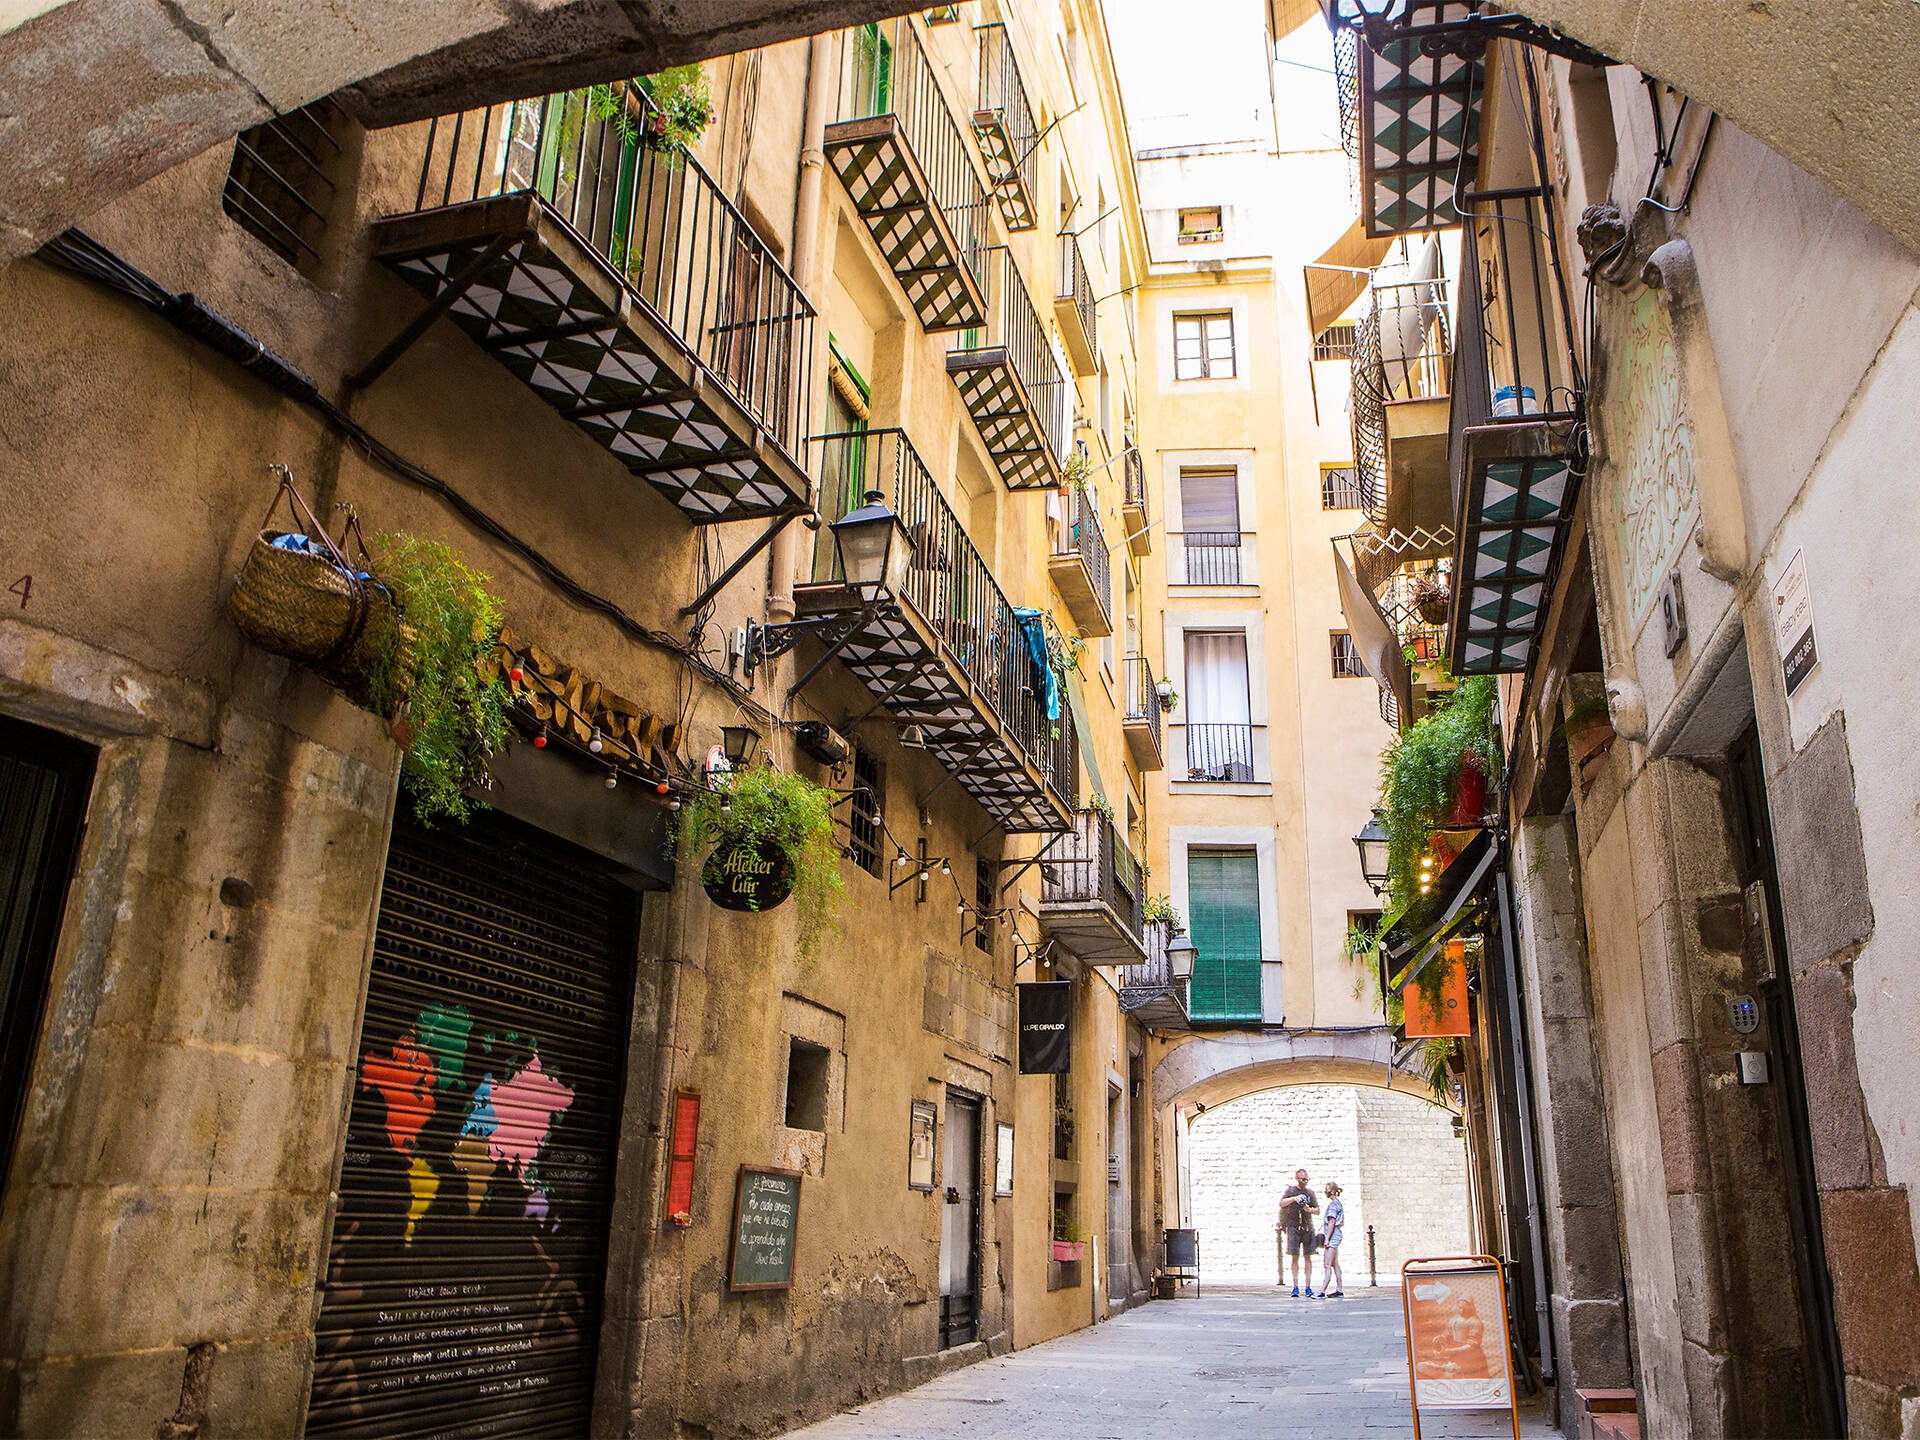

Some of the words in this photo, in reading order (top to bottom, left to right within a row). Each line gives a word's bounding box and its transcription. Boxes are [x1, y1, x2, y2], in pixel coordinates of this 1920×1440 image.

[8, 574, 33, 609] 4
[1663, 594, 1673, 632] 9
[723, 848, 775, 876] Atelier
[1023, 1023, 1039, 1031] LUPE
